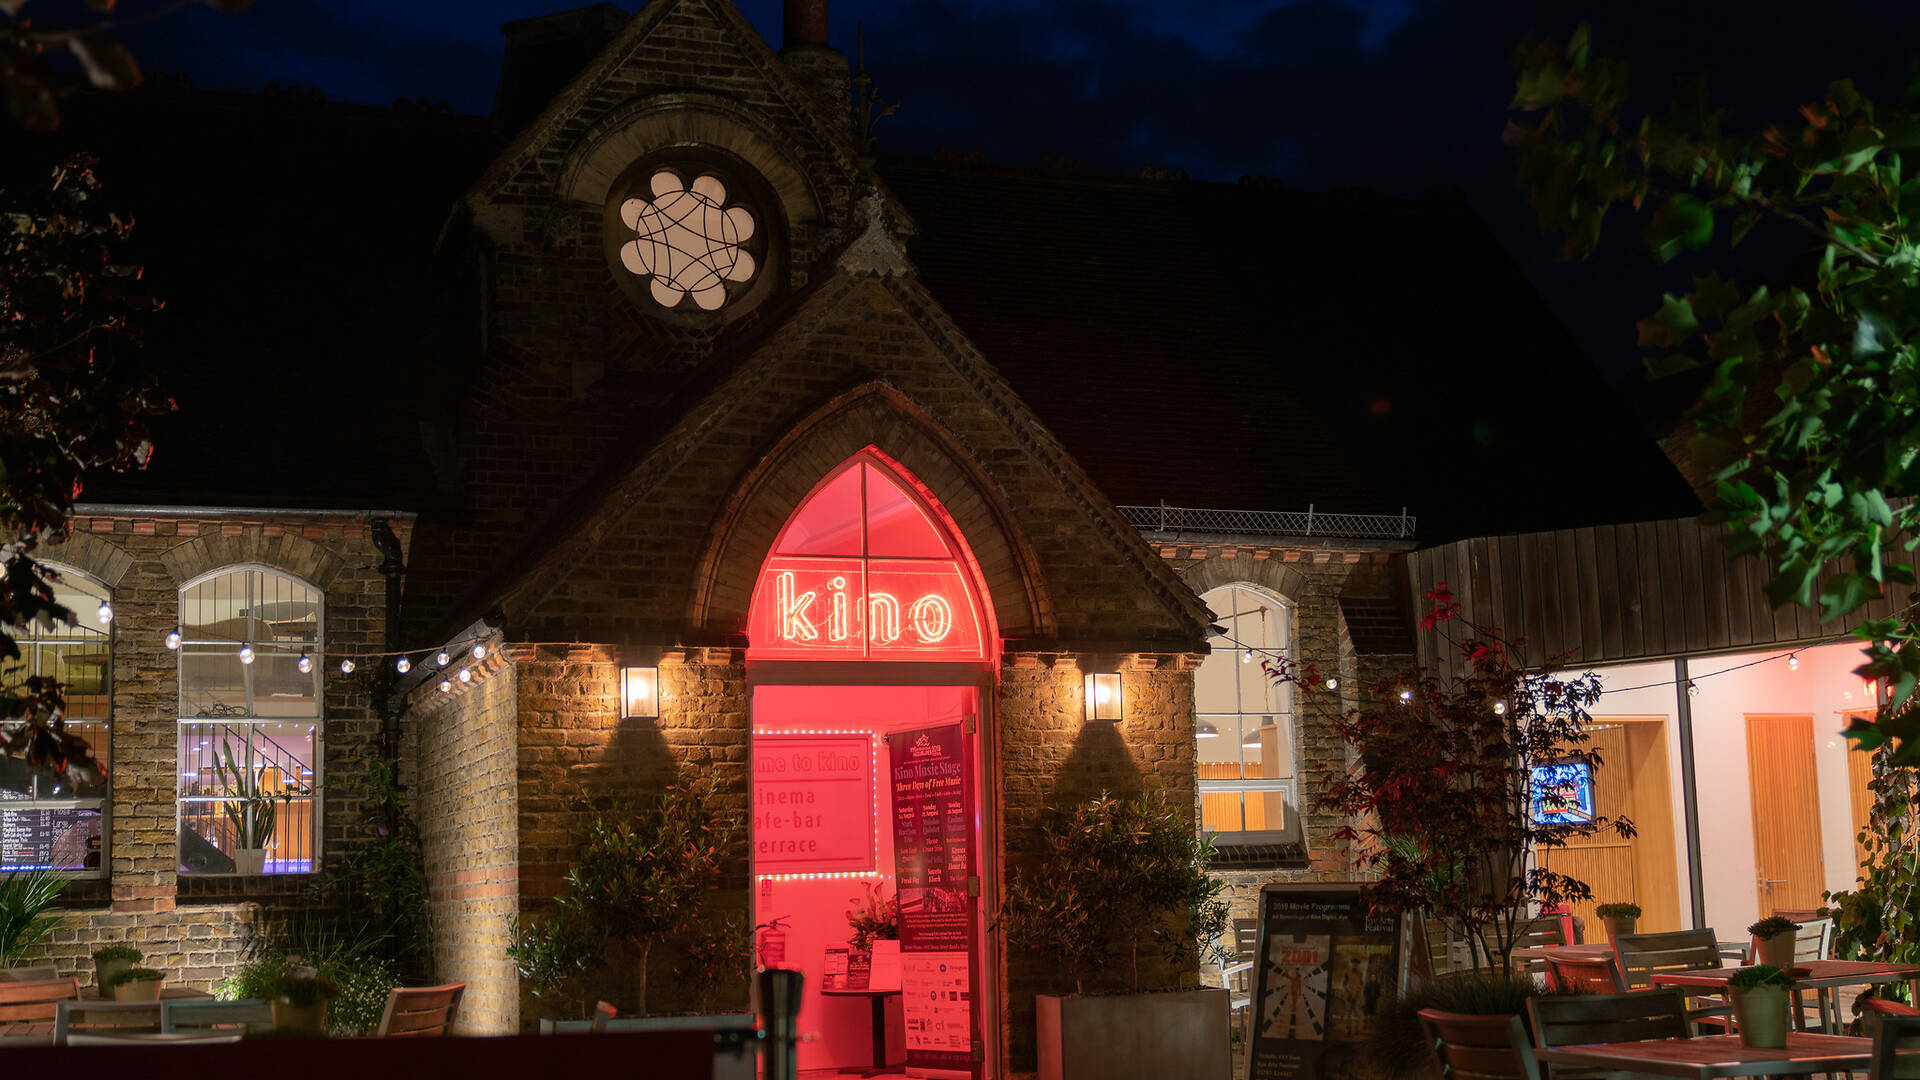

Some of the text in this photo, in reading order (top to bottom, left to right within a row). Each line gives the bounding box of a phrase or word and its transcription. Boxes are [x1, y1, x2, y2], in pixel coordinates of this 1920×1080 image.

[782, 571, 952, 642] kino
[792, 753, 812, 772] to
[818, 751, 860, 771] kino
[894, 761, 961, 780] Kino Music Stage
[754, 839, 817, 854] errace
[1290, 902, 1310, 911] Movie
[1311, 902, 1351, 913] Programme
[1280, 950, 1319, 962] 2001
